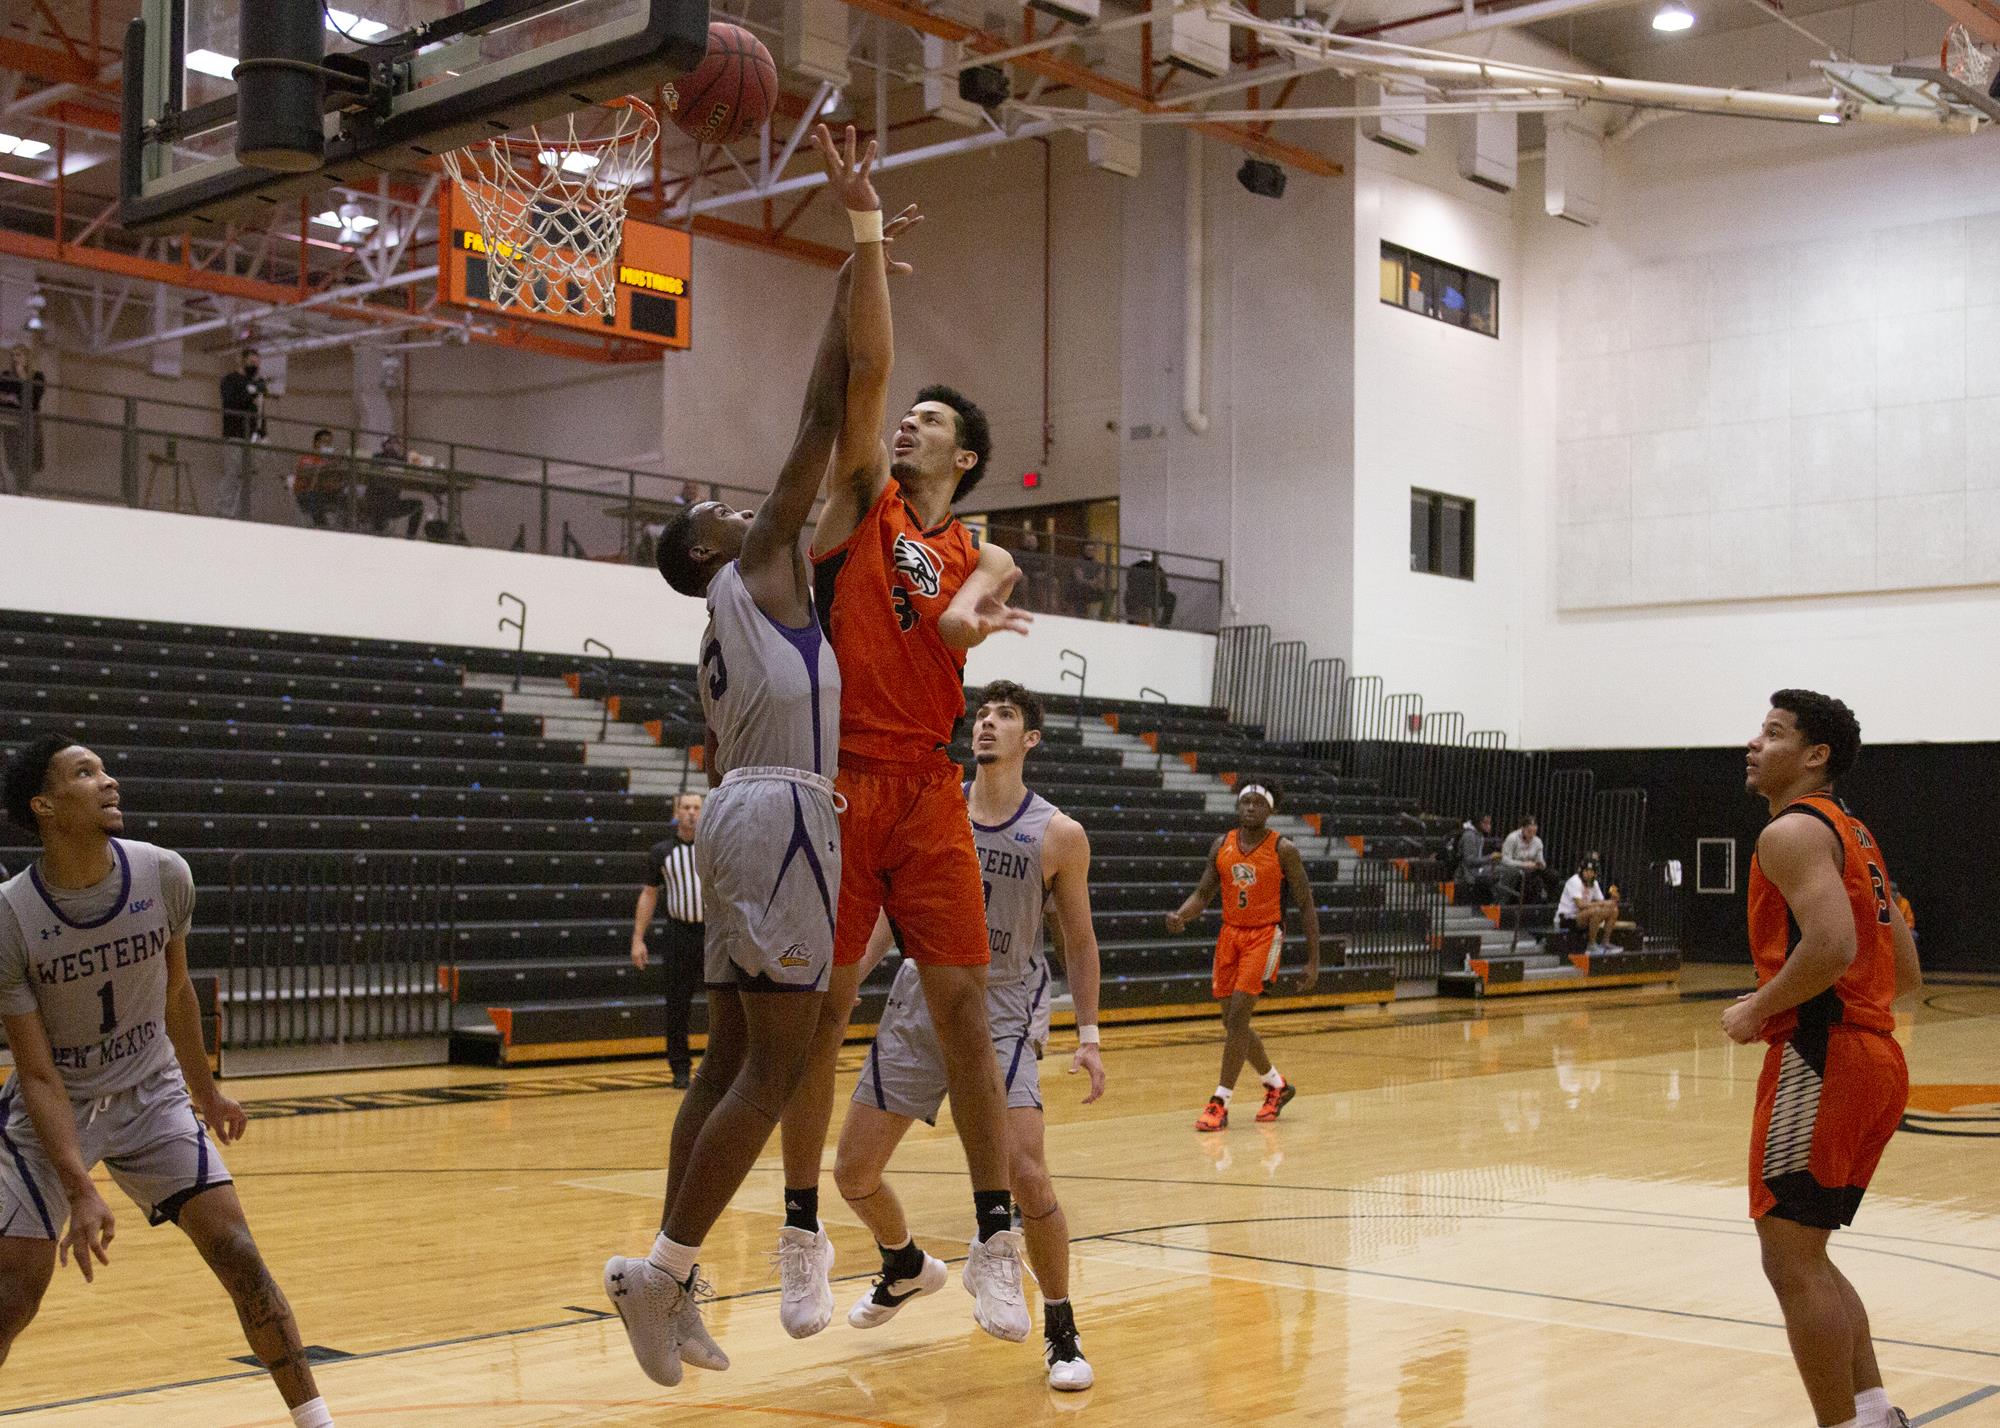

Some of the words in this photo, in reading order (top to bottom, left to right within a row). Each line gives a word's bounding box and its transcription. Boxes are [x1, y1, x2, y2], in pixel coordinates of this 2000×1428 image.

[1237, 889, 1249, 910] 5
[36, 927, 166, 985] WESTERN
[96, 980, 118, 1034] 1
[100, 1020, 157, 1067] MEXIC
